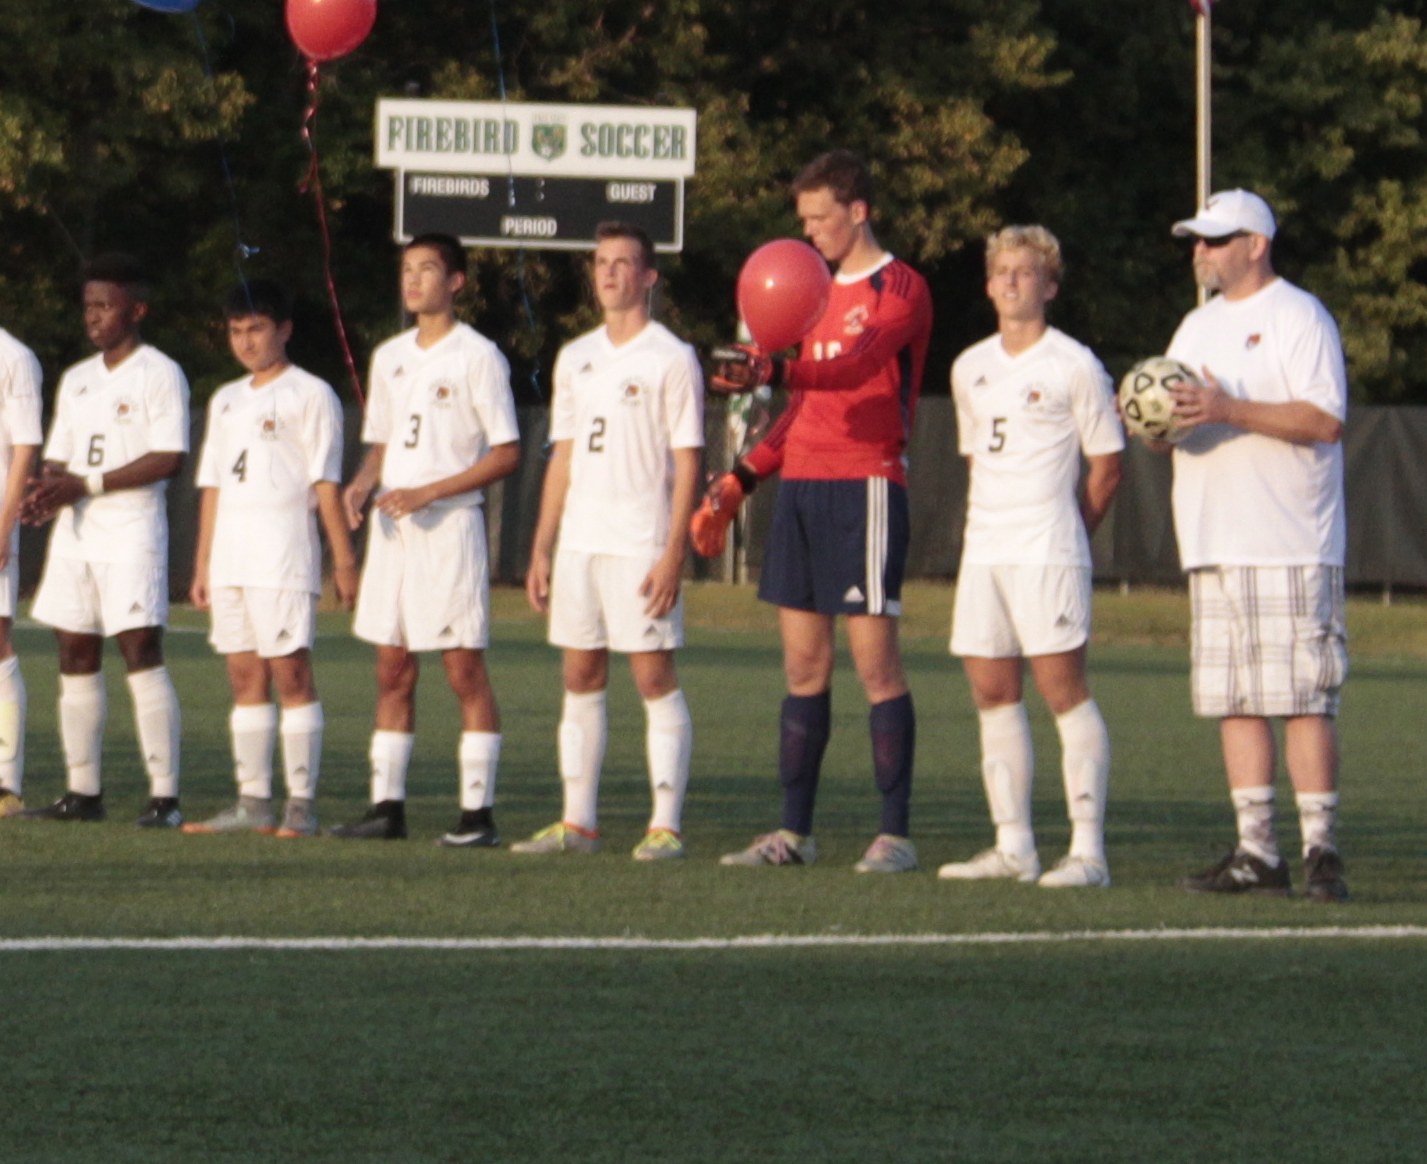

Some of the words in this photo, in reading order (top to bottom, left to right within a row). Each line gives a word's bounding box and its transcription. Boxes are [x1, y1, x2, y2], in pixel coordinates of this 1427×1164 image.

[387, 115, 520, 155] FIREBIRD
[580, 122, 688, 160] SOCCER
[410, 177, 490, 198] FIREBIRDS
[607, 182, 657, 203] GUEST
[501, 215, 557, 236] PERIOD
[404, 414, 421, 449] 3
[588, 417, 606, 453] 2
[988, 417, 1007, 452] 5
[87, 433, 105, 467] 6
[231, 448, 249, 483] 4
